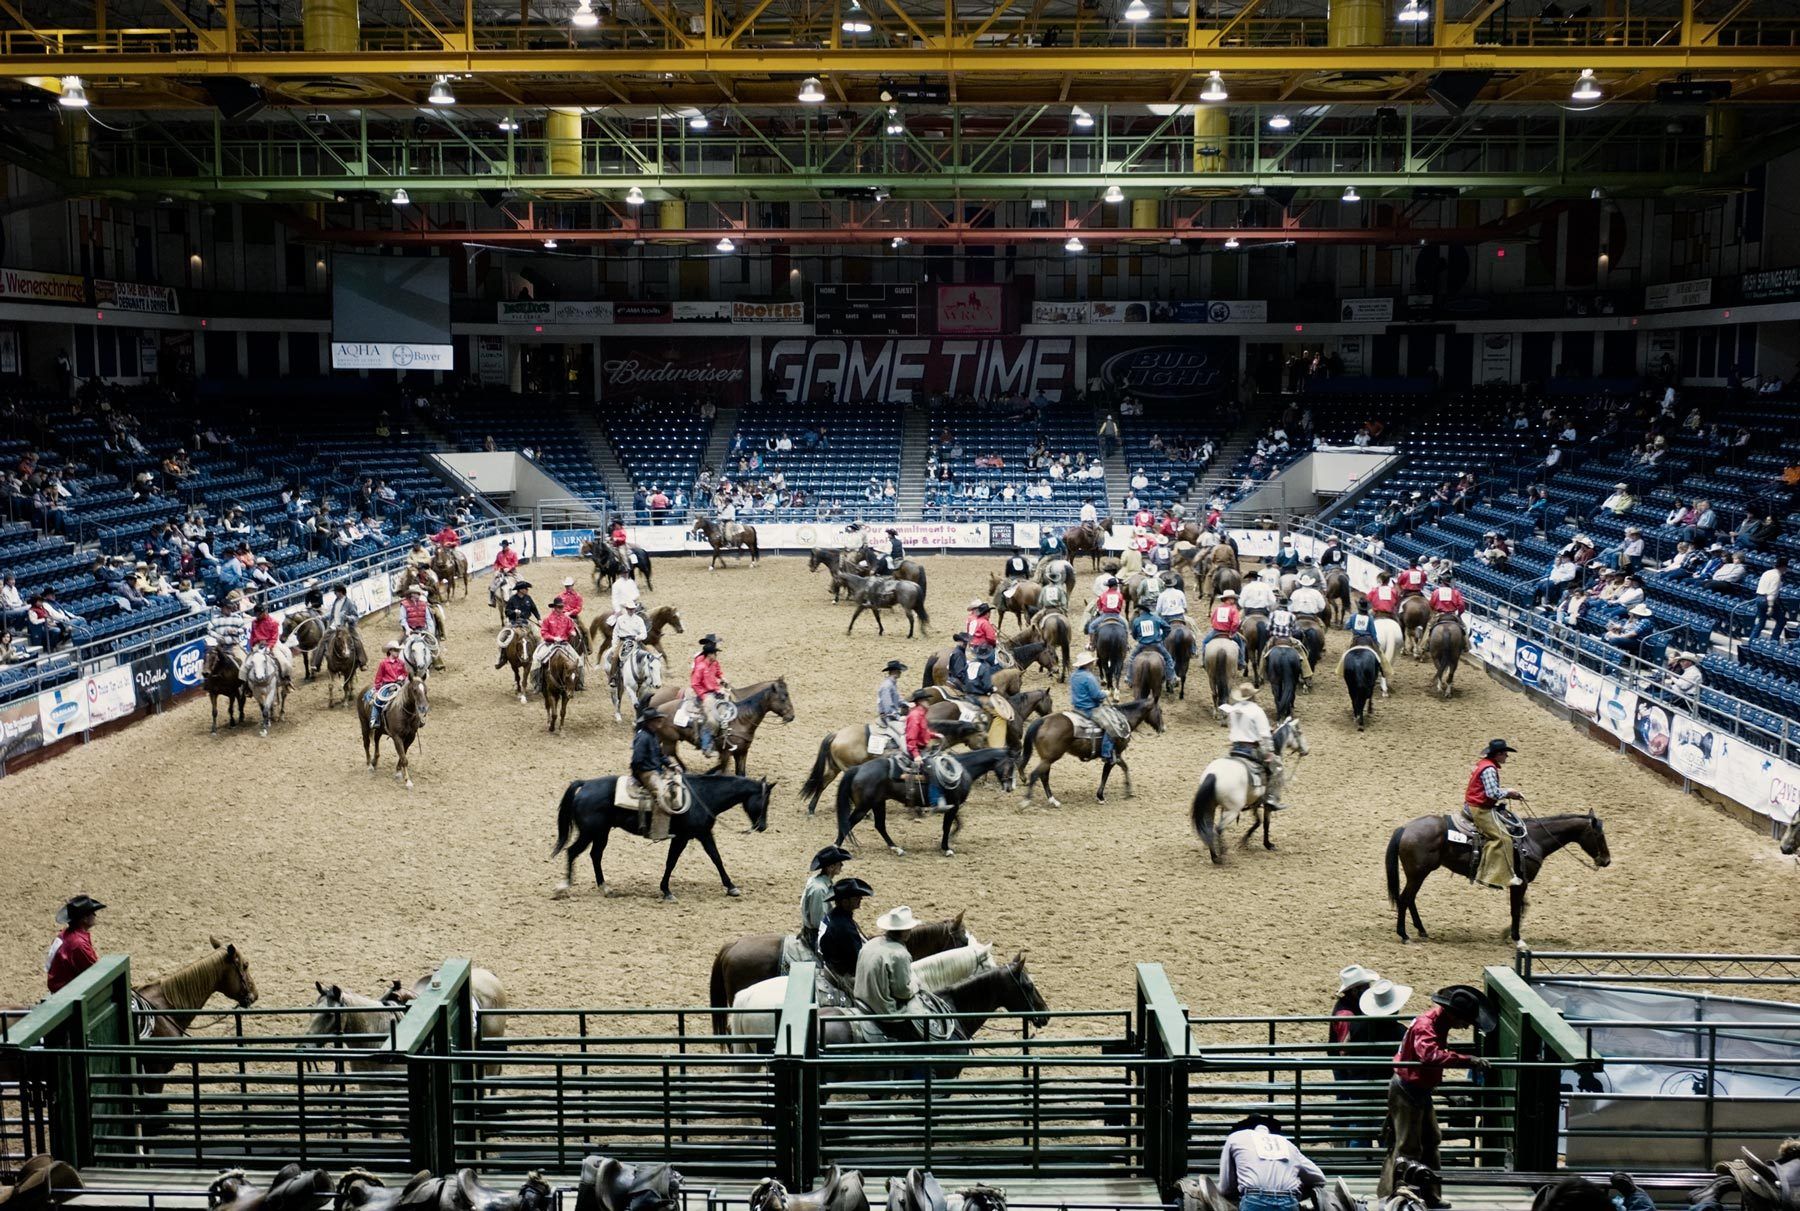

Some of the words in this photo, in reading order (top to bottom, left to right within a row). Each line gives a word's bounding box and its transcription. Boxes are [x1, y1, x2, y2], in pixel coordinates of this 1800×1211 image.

[118, 284, 126, 294] DO
[118, 296, 145, 309] DESIGNATE
[150, 299, 167, 312] DRIVER
[734, 303, 801, 317] HOOTERS
[338, 344, 380, 357] AQHA
[414, 352, 441, 363] Bayer
[1131, 352, 1208, 369] BUD
[603, 360, 744, 384] Budweiser
[768, 339, 931, 403] GAME
[941, 339, 1072, 403] TIME
[1128, 369, 1221, 386] IGHT
[686, 531, 708, 542] NR
[864, 525, 882, 534] Our
[886, 525, 944, 534] mmitment
[947, 525, 957, 534] to
[932, 536, 957, 545] crisis
[180, 649, 200, 666] BUD
[178, 659, 204, 678] LIGHT
[136, 668, 167, 687] Walls
[1770, 777, 1800, 805] CAVE
